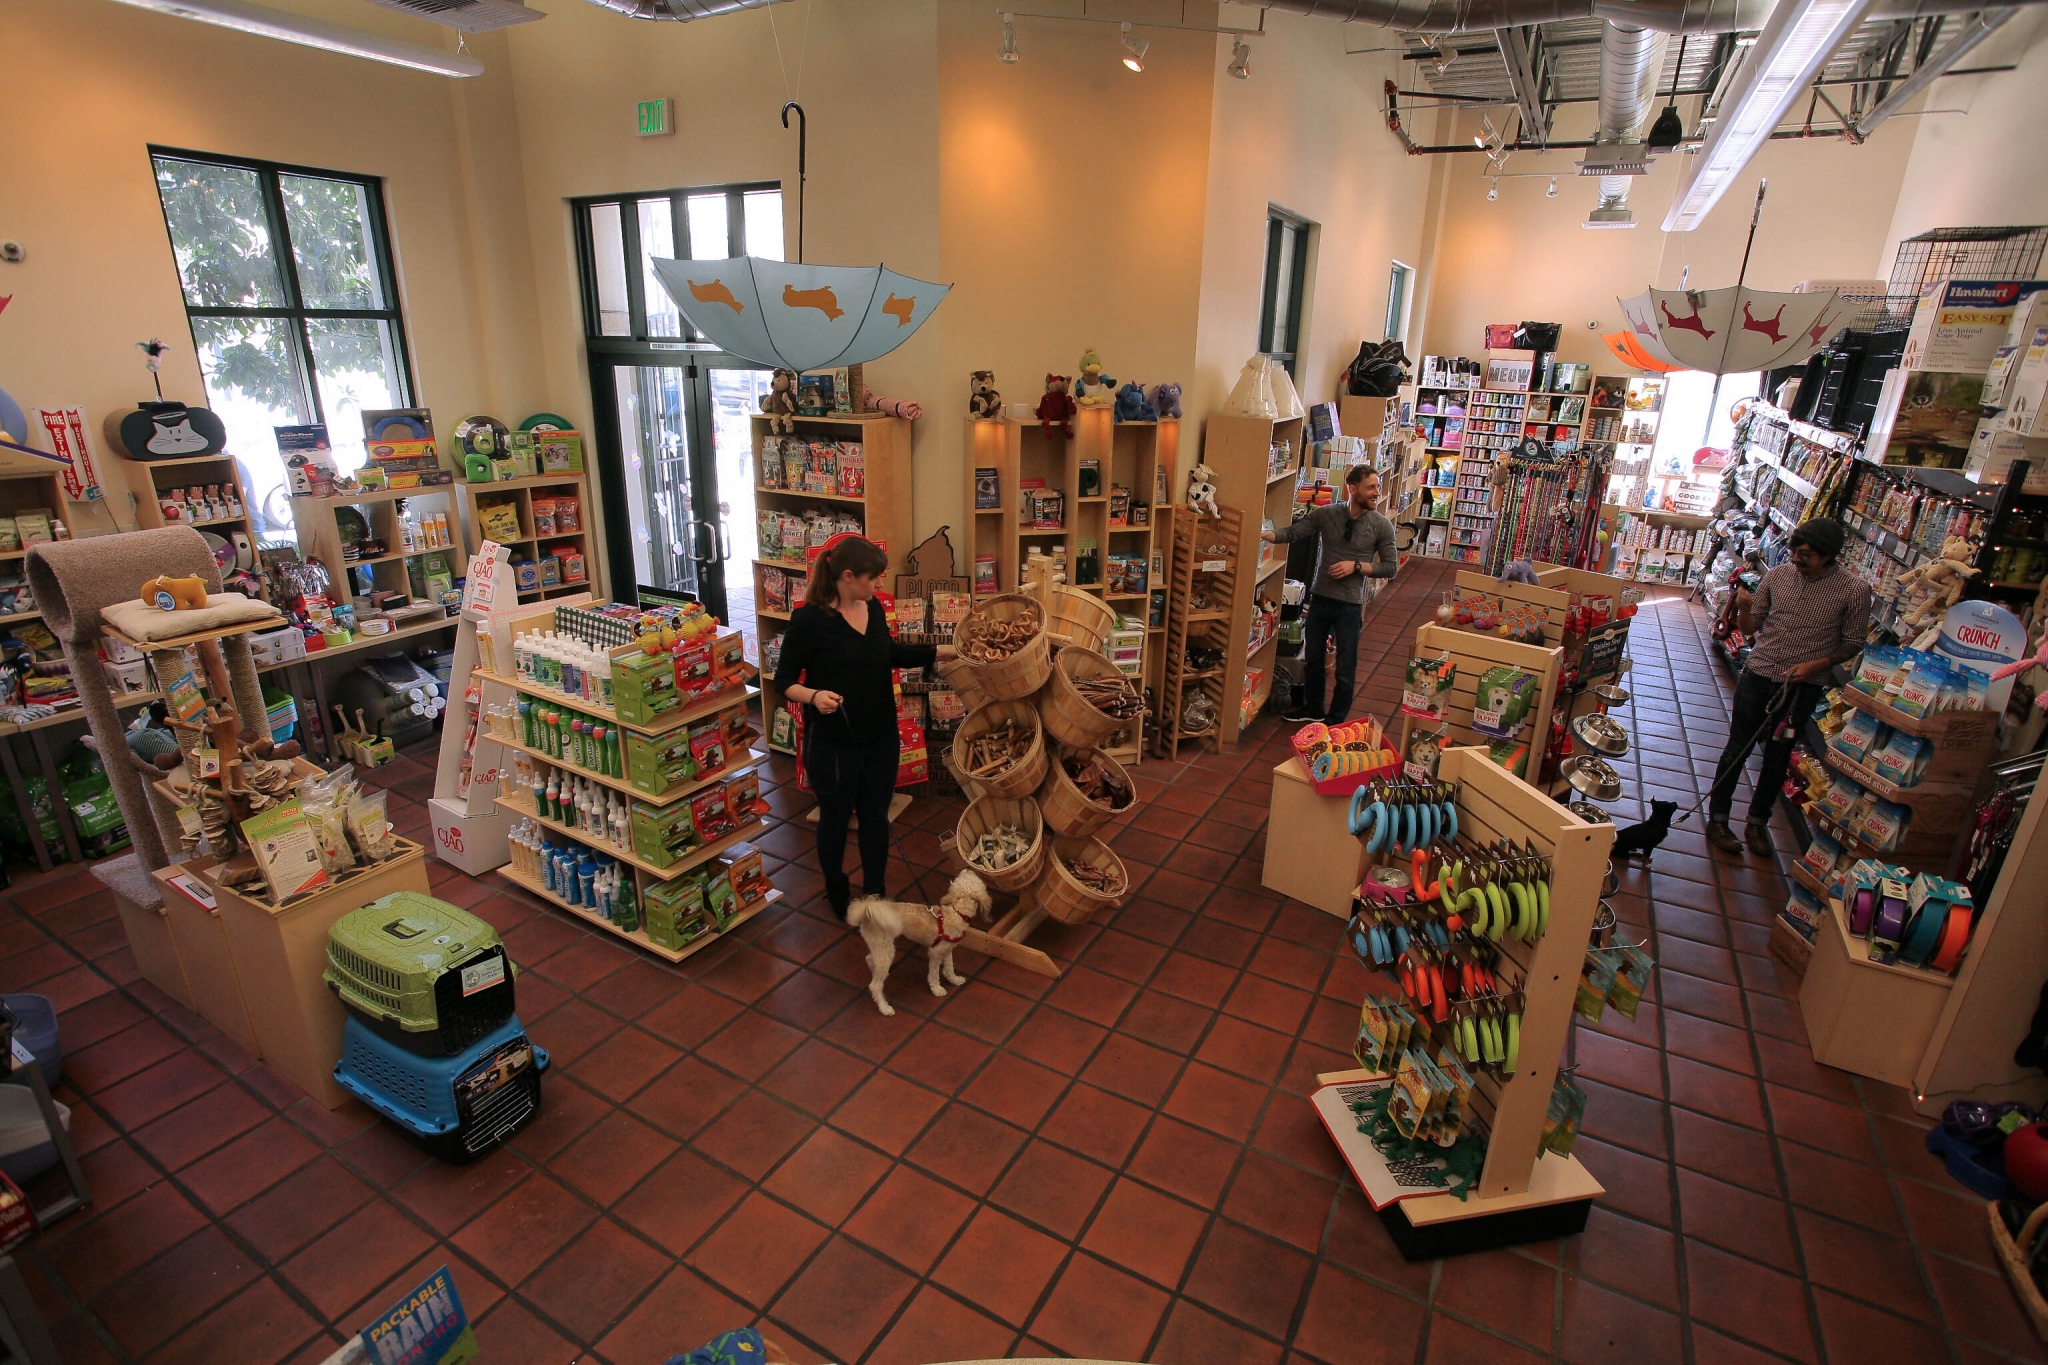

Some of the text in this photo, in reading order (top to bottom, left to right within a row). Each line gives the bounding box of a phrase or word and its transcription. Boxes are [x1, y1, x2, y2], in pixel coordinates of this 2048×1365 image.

[638, 100, 663, 133] EXIT
[1949, 286, 2009, 298] Havahart
[1941, 313, 2011, 326] EASY SET
[1488, 367, 1531, 383] MEOW
[43, 415, 65, 426] FIRE
[68, 414, 80, 425] FIRE
[53, 427, 79, 496] EXTINSHER
[74, 426, 94, 485] EXTINGUISH
[840, 456, 864, 464] THINKER
[807, 474, 832, 483] THINKERS
[473, 561, 493, 579] CIAO
[918, 634, 953, 645] NATUR
[1593, 636, 1622, 651] Stainless Steel
[1957, 625, 2001, 650] CRUNCH
[919, 683, 938, 692] USA
[1903, 689, 1927, 704] CRUNCH
[1842, 732, 1864, 747] CRUNCH
[1882, 755, 1905, 770] CRUNCH
[1828, 752, 1892, 795] Only the good stuff
[1828, 792, 1849, 809] CRUNCH
[1867, 819, 1889, 836] CRUNCH
[437, 827, 464, 853] CIAO
[1789, 905, 1811, 922] CRUNCH
[370, 1275, 446, 1342] PACKABLE
[376, 1287, 454, 1365] RAIN
[398, 1313, 459, 1365] ONCHO
